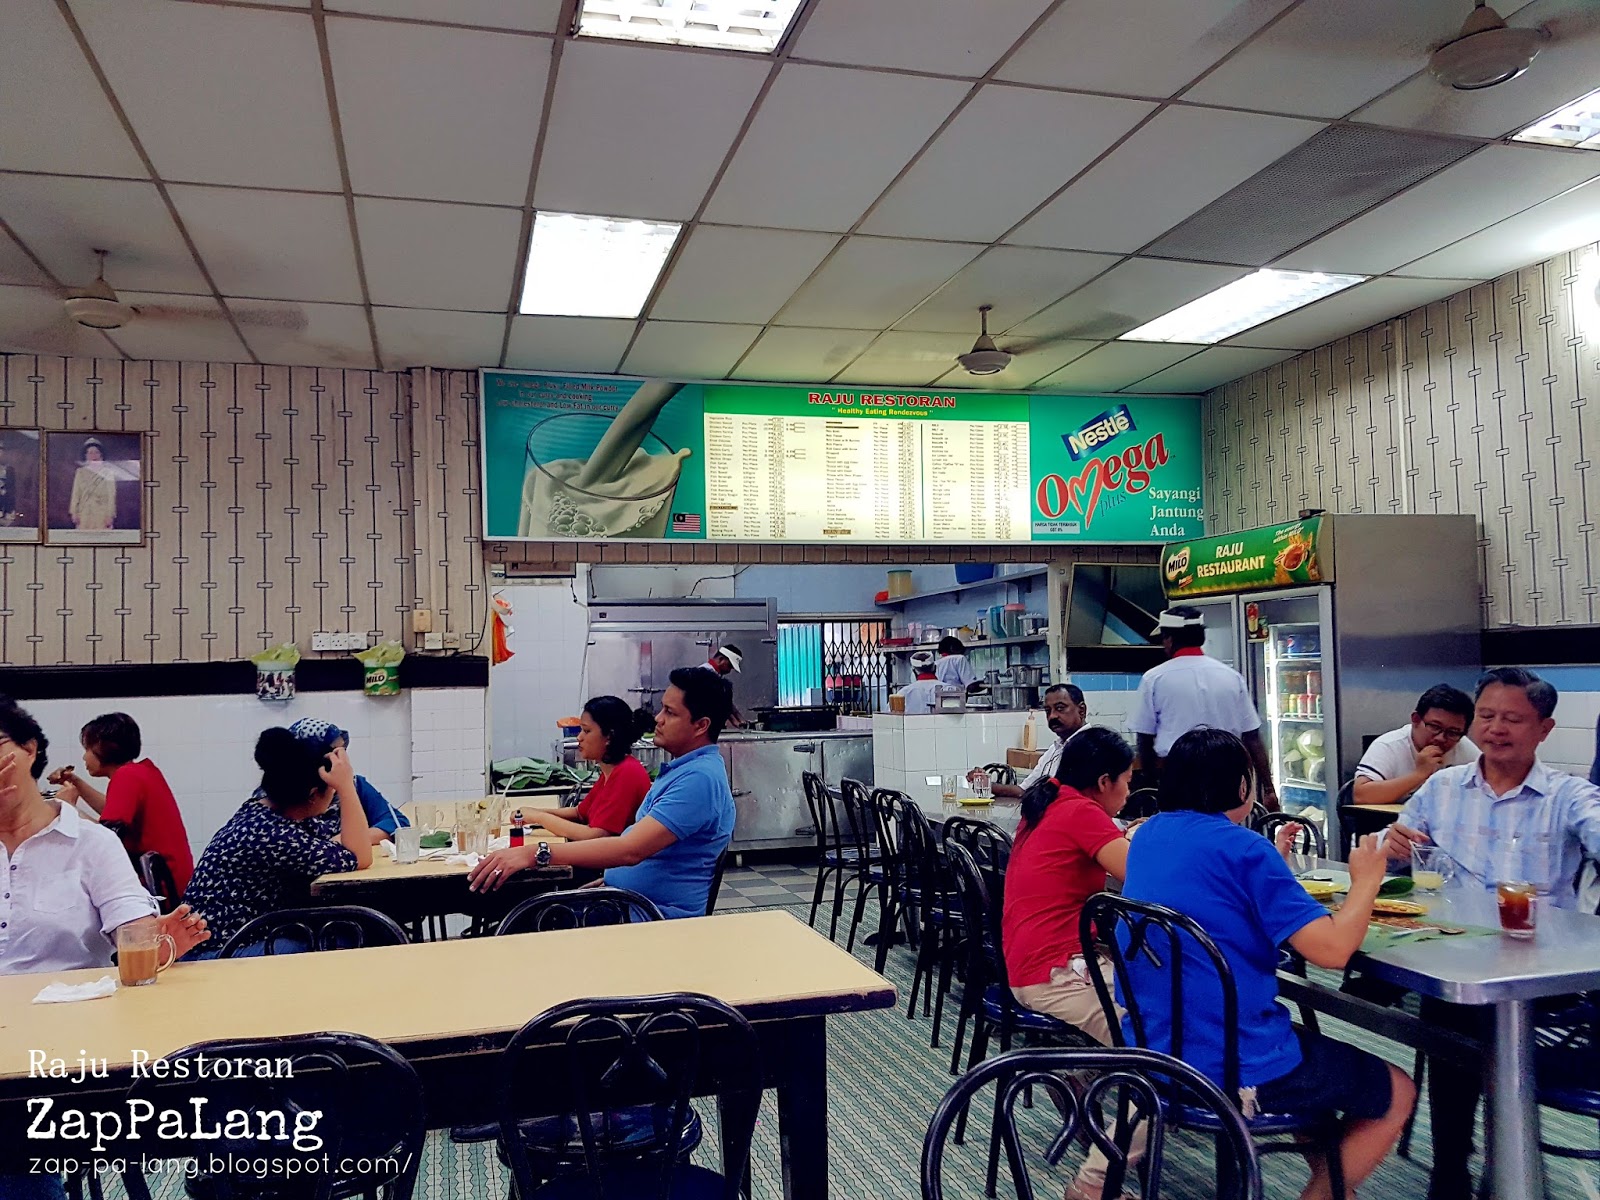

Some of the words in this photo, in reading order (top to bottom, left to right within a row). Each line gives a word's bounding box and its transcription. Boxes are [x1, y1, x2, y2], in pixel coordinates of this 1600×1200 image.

[808, 392, 854, 405] RAJU
[860, 393, 956, 408] RESTORAN
[838, 407, 863, 415] Healthy
[865, 408, 887, 416] Eating
[888, 408, 928, 416] Rendezvous
[1149, 487, 1201, 502] Sayangi
[1100, 491, 1126, 517] plus
[1150, 505, 1204, 520] Jantung
[1150, 523, 1185, 536] Anda
[1215, 542, 1244, 558] RAJU
[1168, 556, 1187, 573] MILO
[1196, 555, 1266, 578] RESTAURANT
[366, 674, 385, 684] MILO
